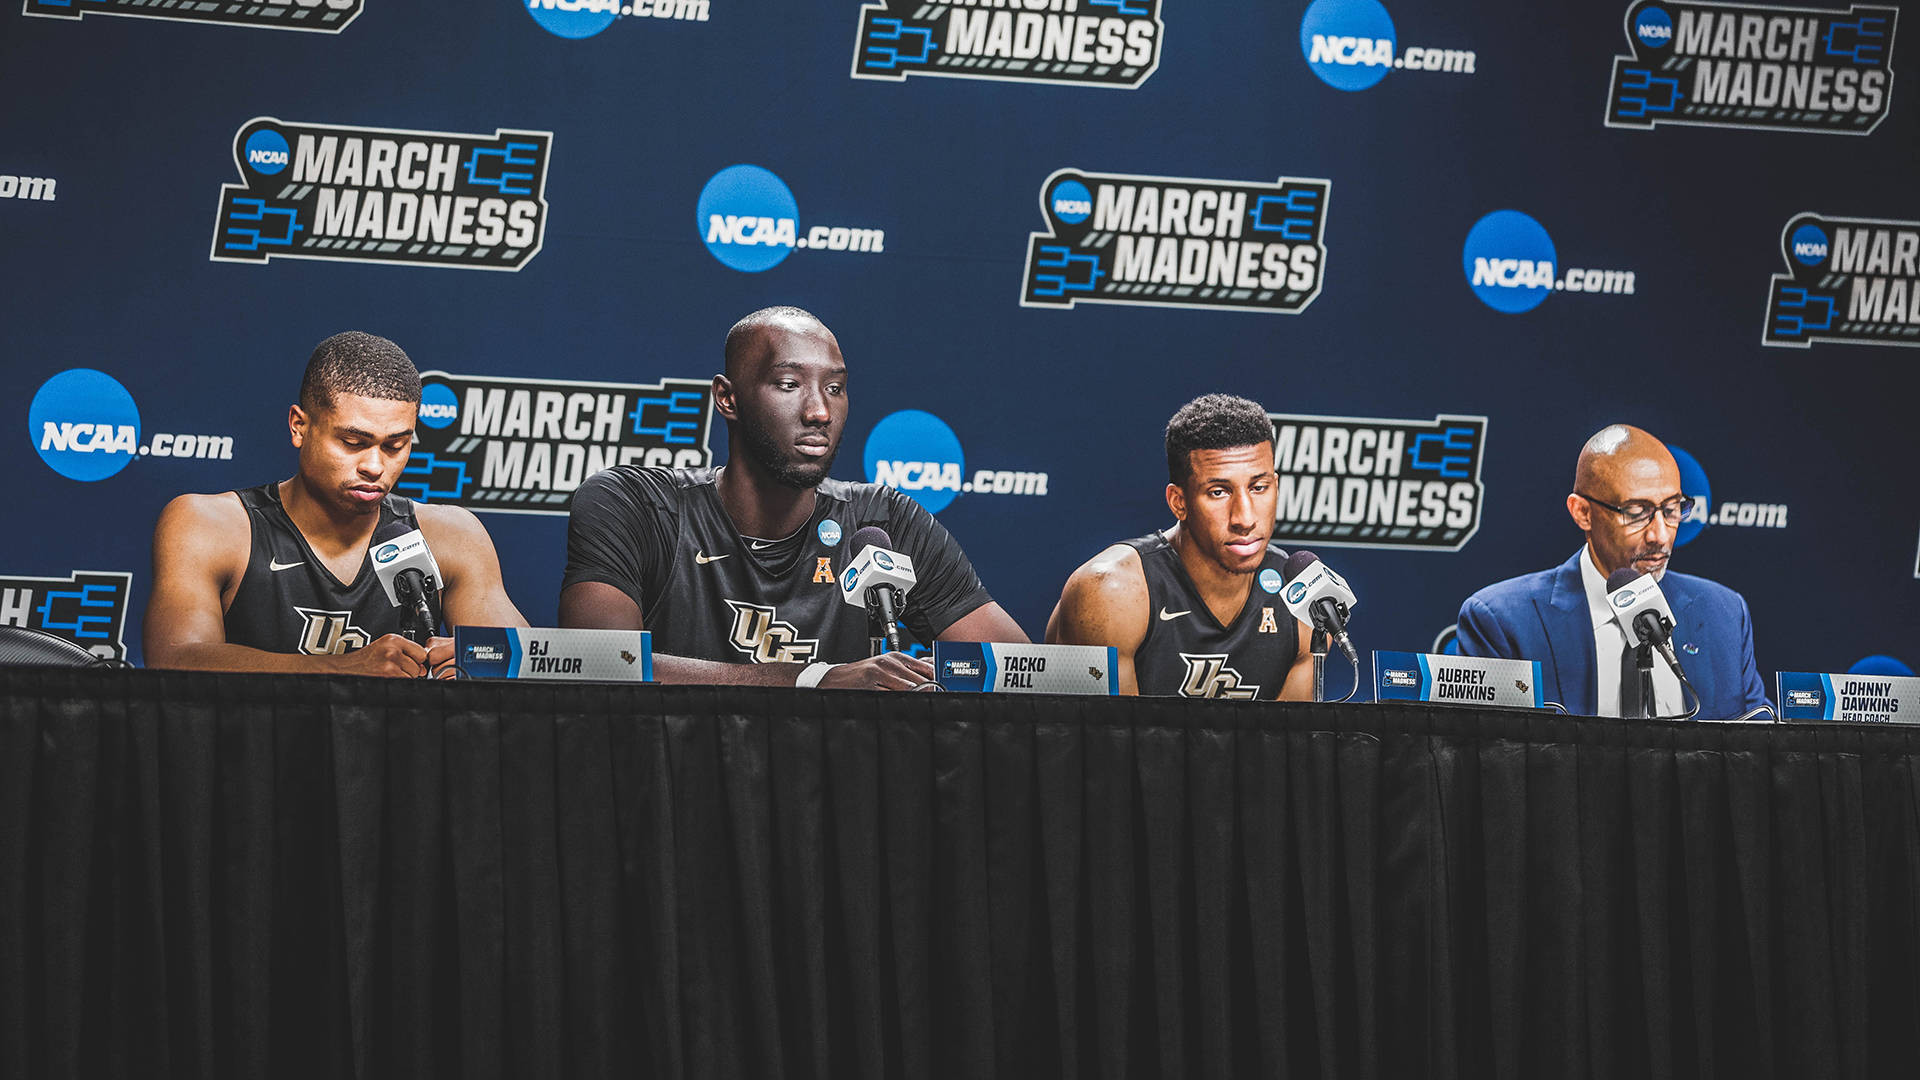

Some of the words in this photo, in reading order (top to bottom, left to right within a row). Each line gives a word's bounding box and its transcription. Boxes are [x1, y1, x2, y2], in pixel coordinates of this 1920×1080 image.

[945, 8, 1154, 66] MADNESS
[1638, 22, 1671, 39] NCAA
[1674, 11, 1818, 62] MARCH
[1310, 34, 1475, 73] NCAA.com
[1692, 60, 1885, 113] MADNESS
[248, 149, 289, 165] NCAA
[291, 134, 460, 191] MARCH
[1054, 199, 1092, 216] NCAA
[1096, 184, 1247, 238] MARCH
[313, 188, 538, 248] MADNESS
[706, 214, 885, 252] NCAA.com
[1795, 240, 1827, 257] NCAA
[1112, 236, 1319, 292] MADNESS
[1472, 257, 1635, 294] NCAA.com
[419, 404, 457, 419] NCAA
[461, 387, 626, 442] MARCH
[40, 421, 233, 460] NCAA.com
[875, 460, 1048, 496] NCAA.com
[1276, 475, 1475, 528] MADNESS
[299, 610, 368, 655] UC
[476, 652, 503, 660] MADNESS
[529, 640, 549, 656] BJ
[530, 657, 582, 674] TAYLOR
[953, 668, 979, 676] MADNESS
[1003, 656, 1046, 672] TACKO
[1003, 673, 1033, 689] FALL
[1437, 668, 1486, 685] AUBREY
[1438, 684, 1496, 701] DAWKINS
[1840, 681, 1892, 697] JOHNNY
[1842, 697, 1899, 713] DAWKINS
[1842, 713, 1862, 721] HEAD
[1864, 714, 1890, 722] COACH
